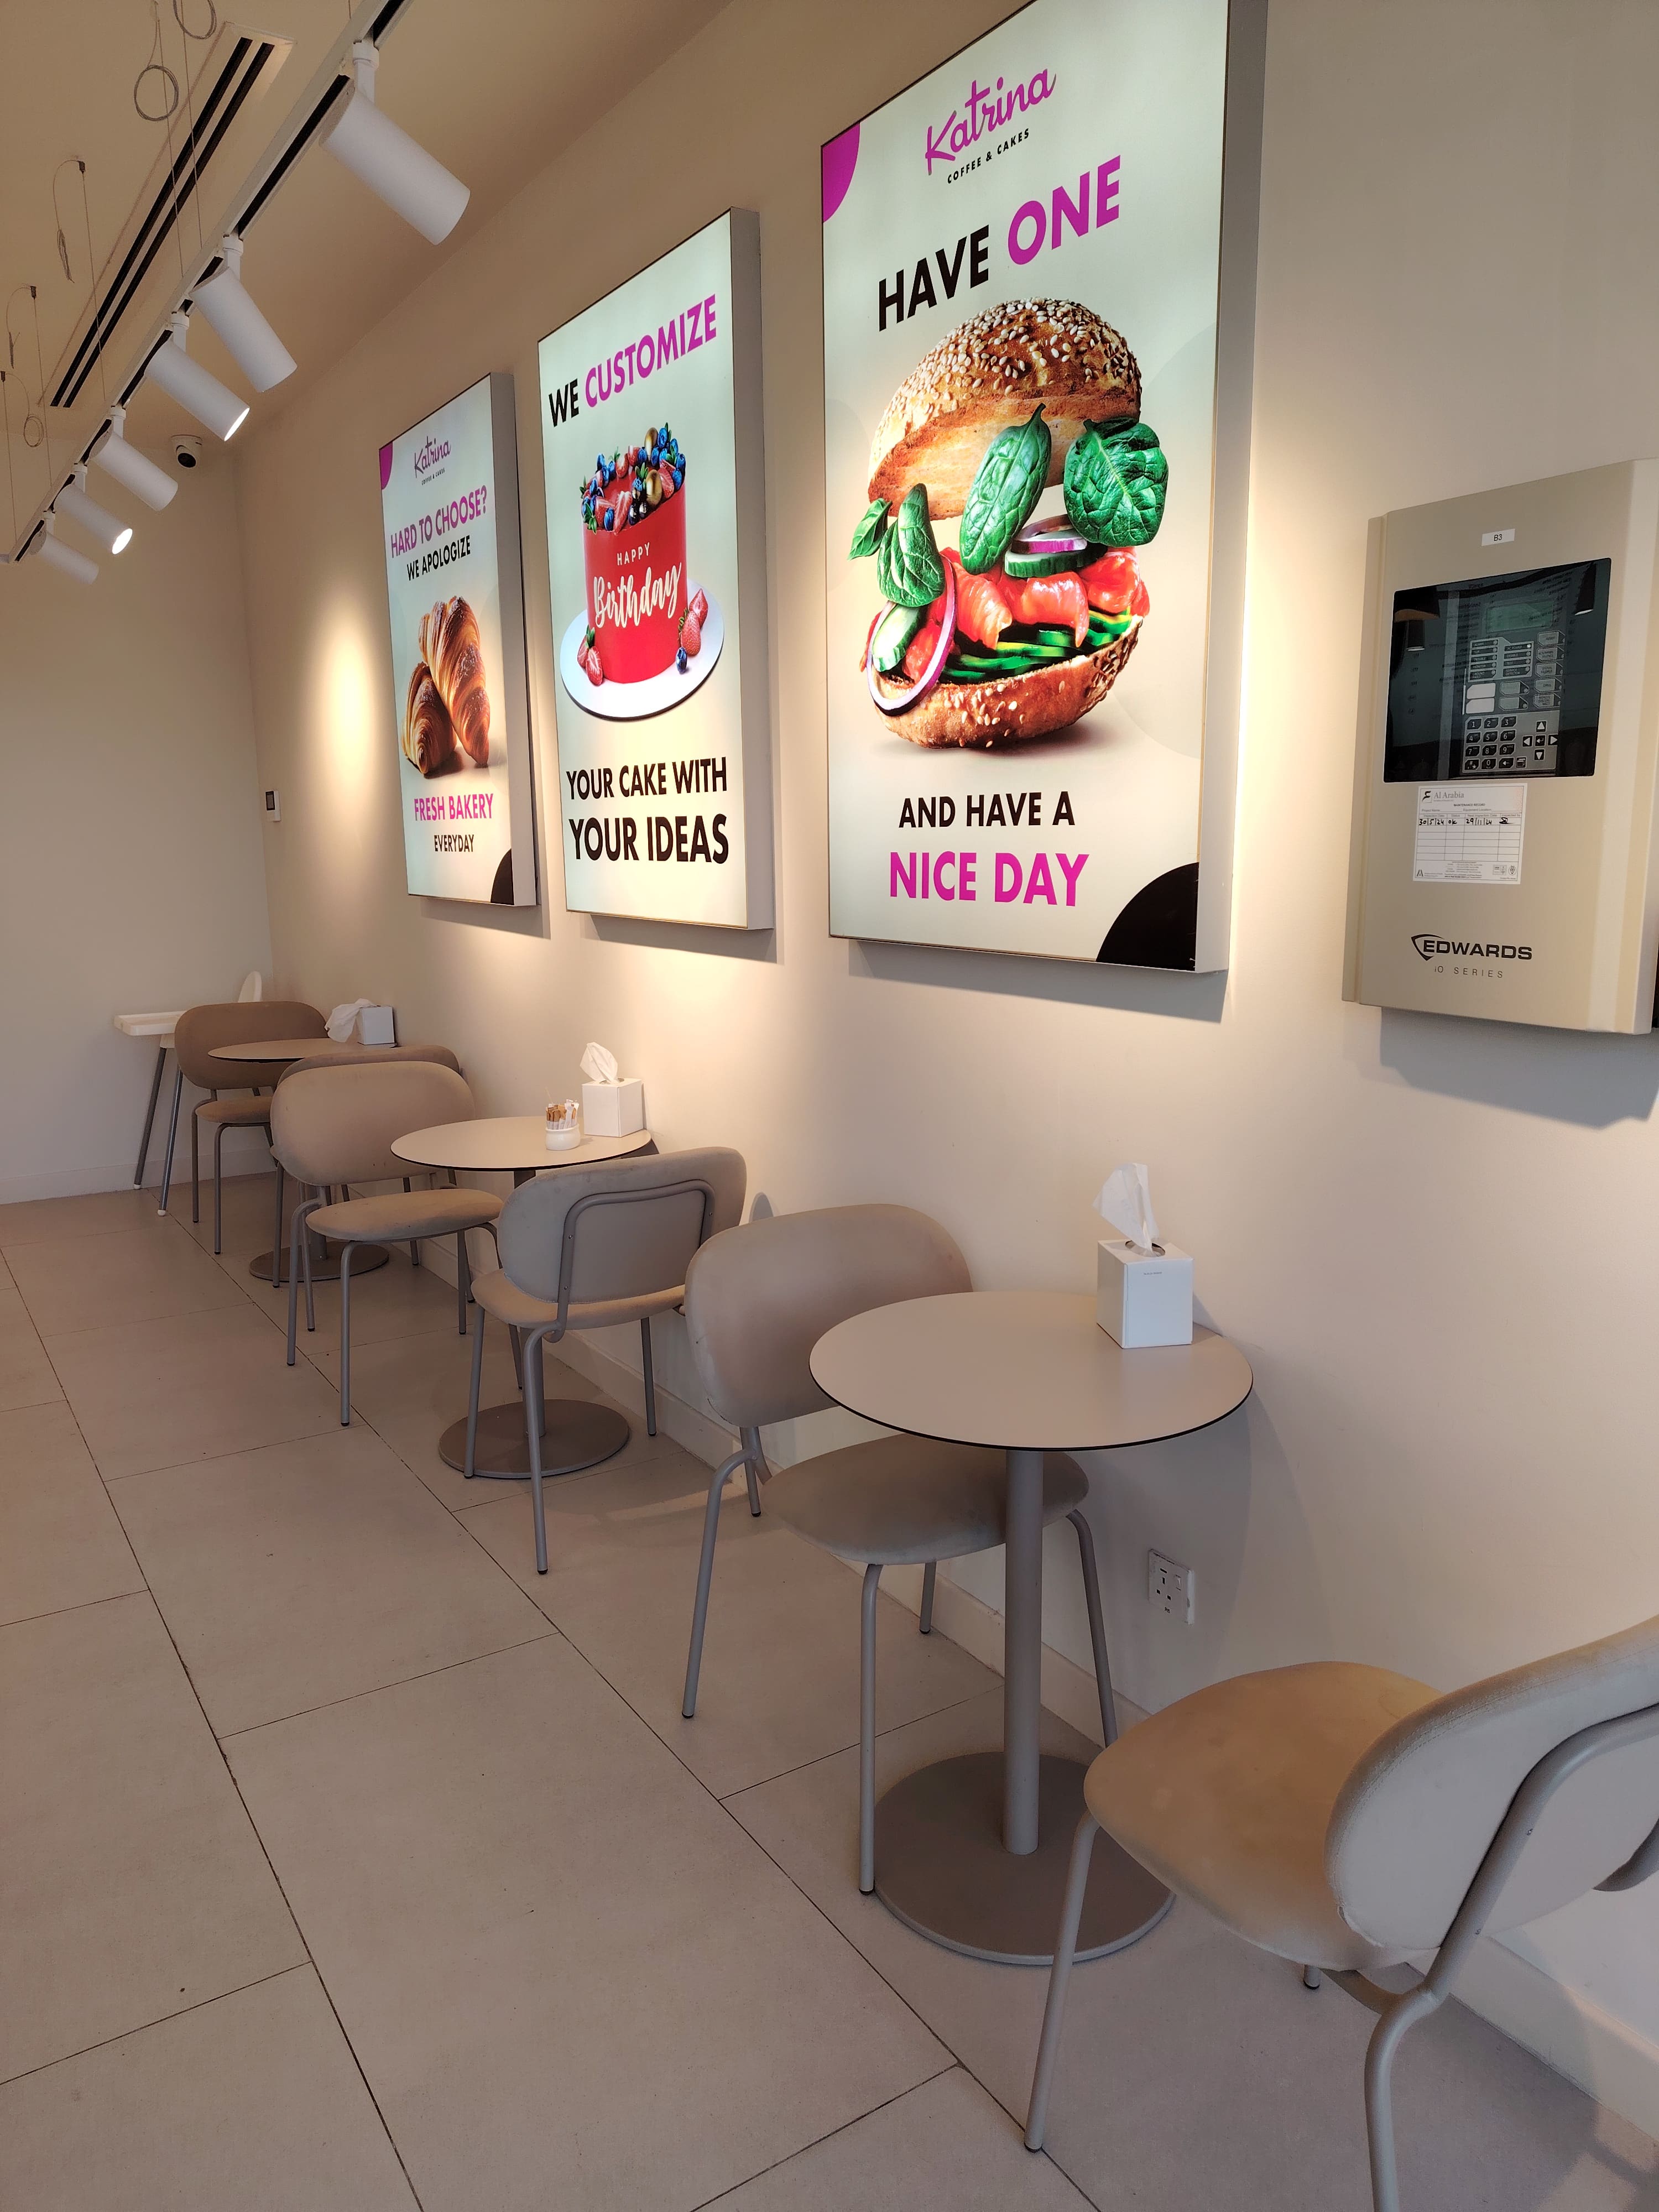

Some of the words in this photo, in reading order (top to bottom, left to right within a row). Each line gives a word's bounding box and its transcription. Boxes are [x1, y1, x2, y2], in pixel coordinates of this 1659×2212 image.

[925, 69, 1056, 175] Katrina
[947, 156, 981, 184] COFFEE
[986, 151, 992, 161] &
[997, 128, 1029, 154] CAKES
[879, 225, 989, 332] HAVE
[1008, 155, 1121, 265] ONE
[549, 378, 579, 427] WE
[585, 294, 716, 407] CUSTOMIZE
[415, 435, 451, 478] Katrina
[390, 524, 417, 559] HARD
[419, 515, 432, 544] TO
[435, 485, 487, 536] CHOOSE?
[407, 559, 420, 581] WE
[422, 535, 471, 575] APOLOGIZE
[617, 542, 650, 566] HAPPY
[593, 562, 682, 628] Birthday
[566, 768, 614, 800] YOUR
[619, 762, 666, 797] CAKE
[672, 757, 727, 794] WITH
[414, 796, 445, 821] FRESH
[448, 793, 493, 820] BAKERY
[899, 796, 955, 828] AND
[966, 792, 1041, 827] HAVE
[1052, 791, 1075, 826] A
[434, 834, 474, 852] EVERYDAY
[568, 817, 639, 861] YOUR
[646, 813, 728, 864] IDEAS
[890, 851, 977, 901] NICE
[994, 853, 1089, 906] DAY
[1423, 940, 1532, 960] EDWARDS
[1454, 967, 1503, 978] SERIES
